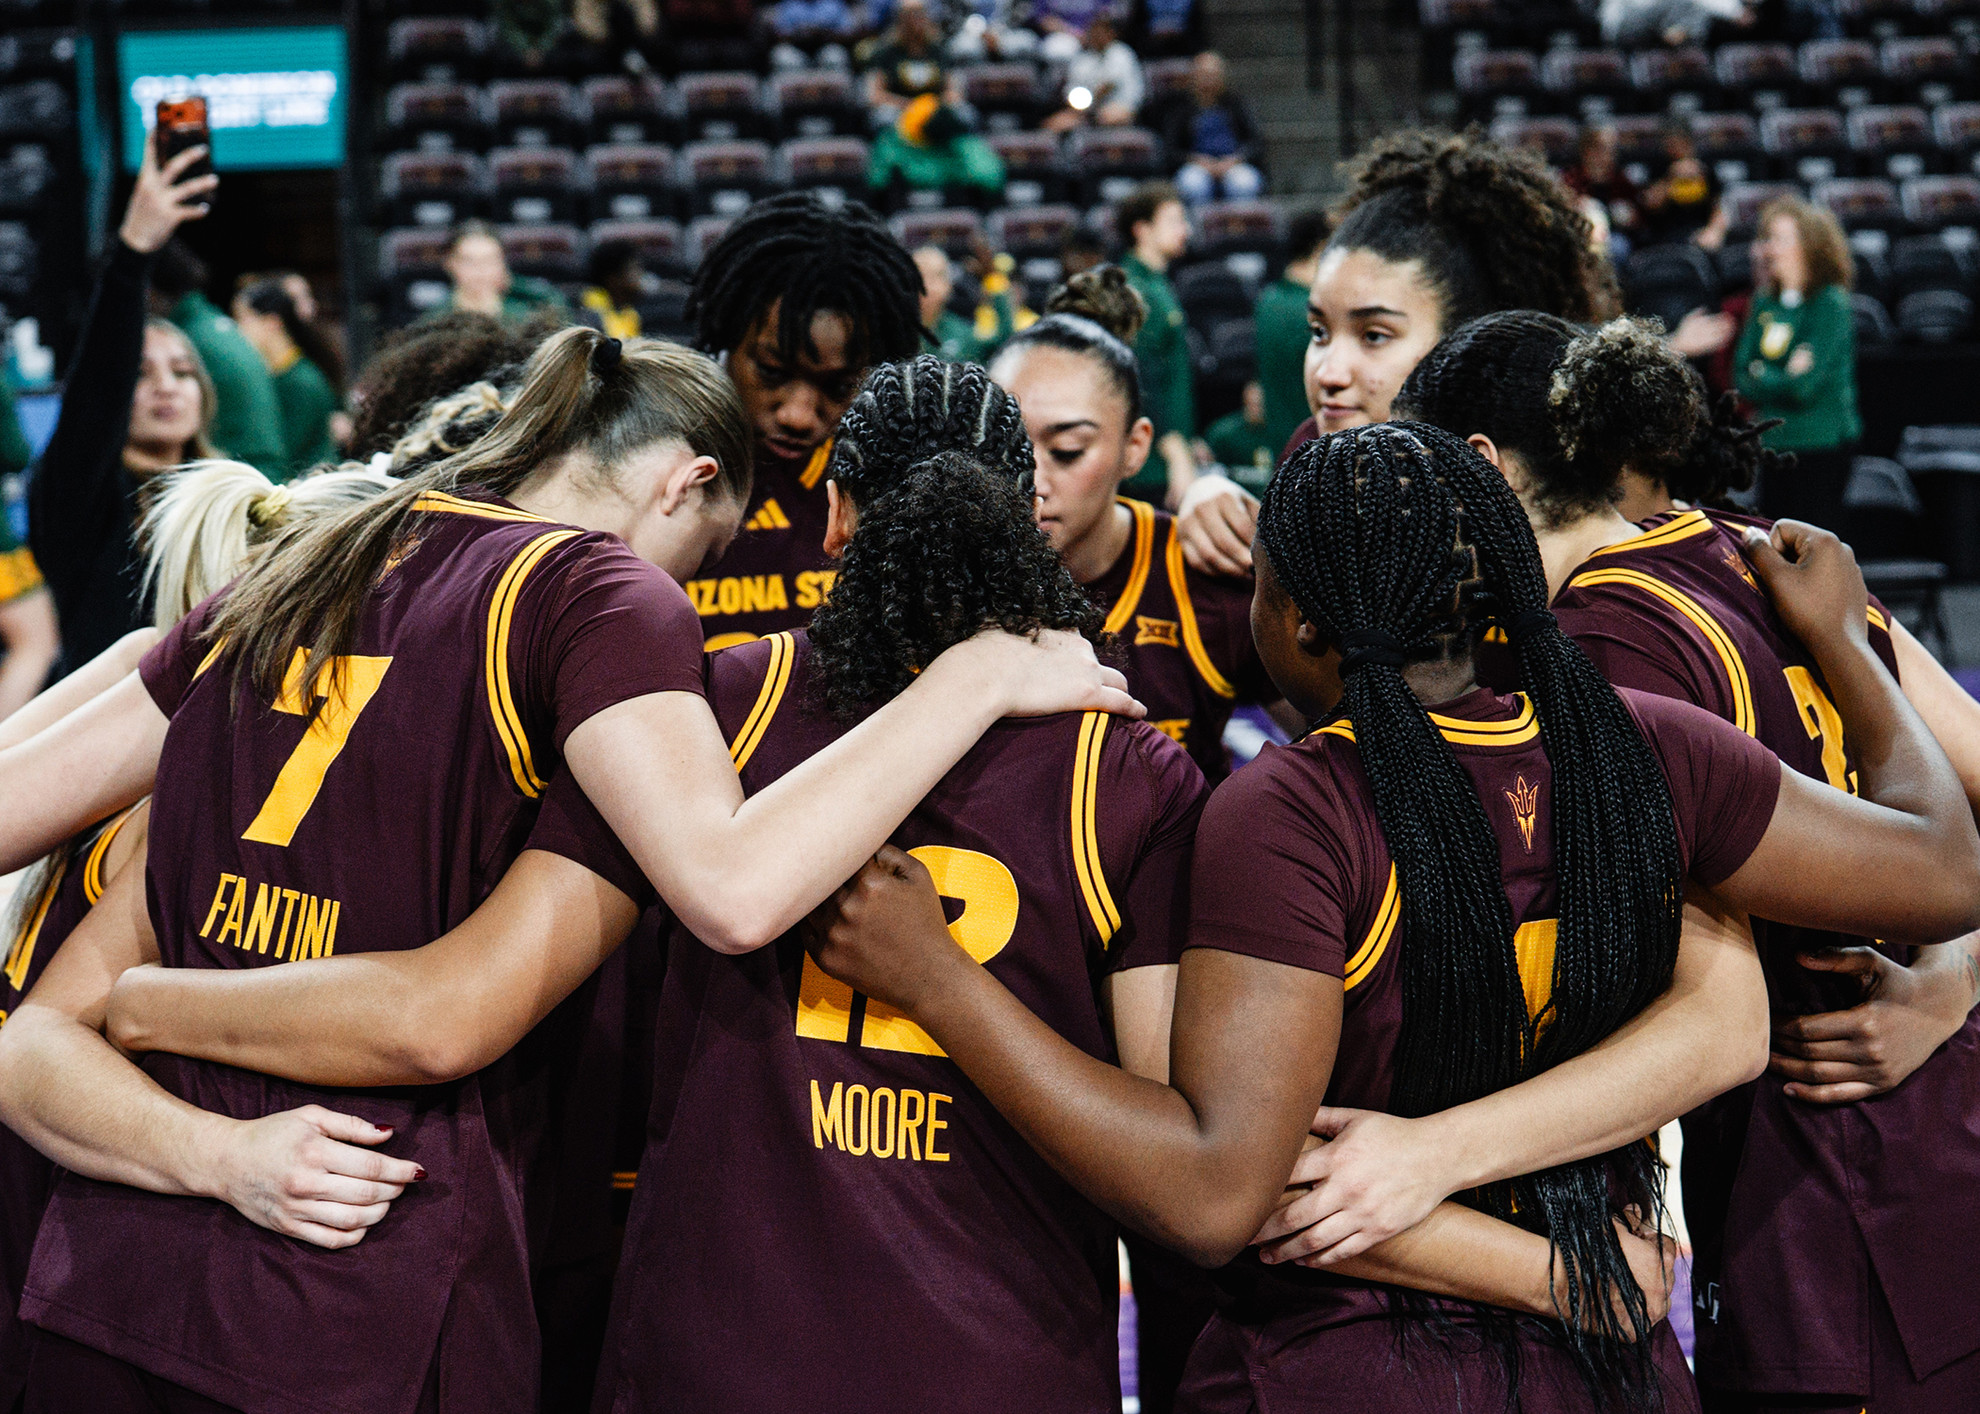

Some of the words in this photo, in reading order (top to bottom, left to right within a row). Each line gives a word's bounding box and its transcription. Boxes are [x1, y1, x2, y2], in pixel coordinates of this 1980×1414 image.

[685, 573, 789, 616] IZONA
[795, 570, 843, 609] ST
[241, 646, 393, 847] 7
[199, 872, 341, 962] FANTINI
[810, 1079, 953, 1162] MOORE
